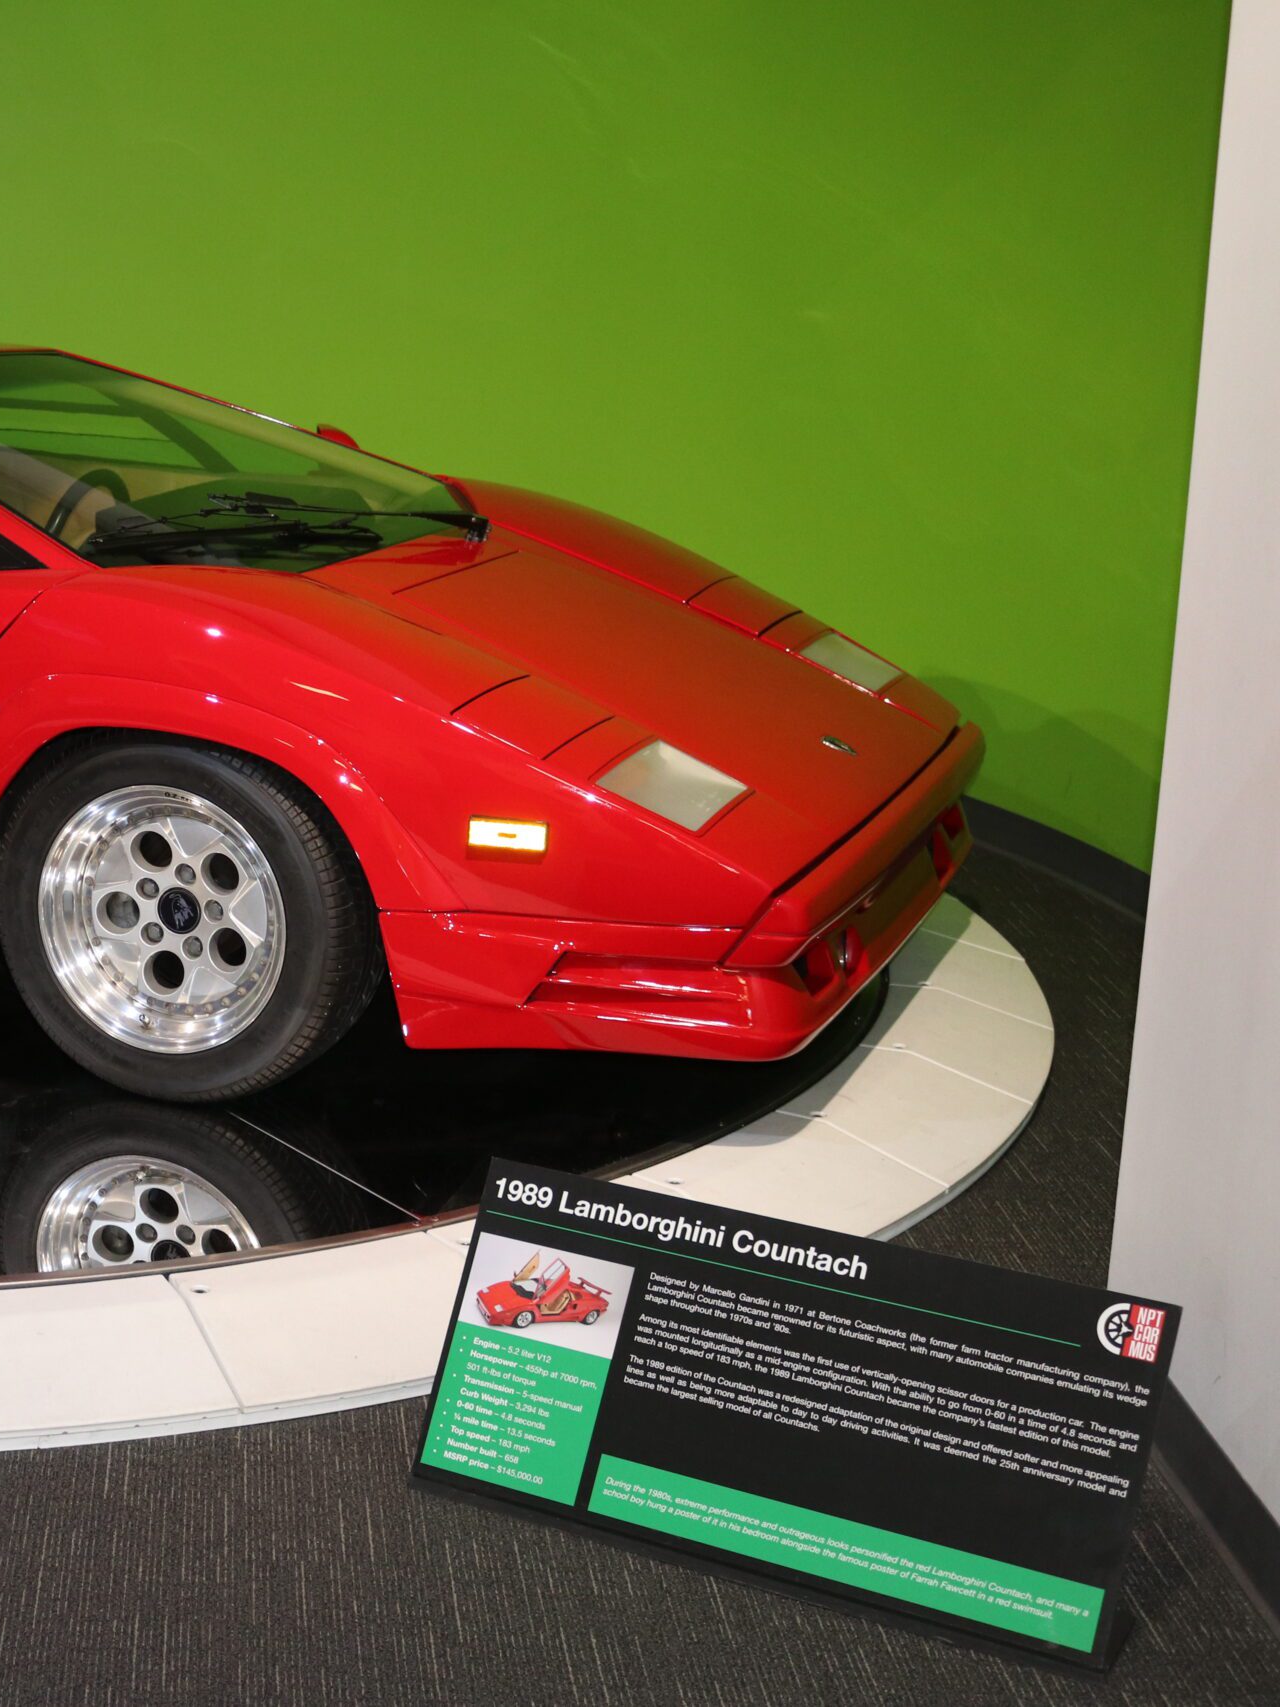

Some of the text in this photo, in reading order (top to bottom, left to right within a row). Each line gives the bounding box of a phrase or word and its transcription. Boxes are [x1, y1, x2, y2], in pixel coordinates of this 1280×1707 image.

[495, 1177, 868, 1280] 1989 Lamborghini Countach
[644, 1293, 669, 1305] shape
[669, 1298, 713, 1316] throughout
[729, 1312, 753, 1325] 1970s
[649, 1271, 687, 1287] Designed
[701, 1283, 736, 1299] Marcello
[738, 1292, 770, 1307] Gandini
[784, 1303, 804, 1314] 1971
[818, 1311, 852, 1326] Bertone
[854, 1319, 907, 1339] Coachworks
[929, 1336, 958, 1350] former
[961, 1344, 981, 1356] farm
[984, 1349, 1014, 1363] tractor
[1016, 1358, 1080, 1381] manufacturing
[1136, 1306, 1164, 1328] NPT
[472, 1336, 501, 1350] Engine
[520, 1349, 536, 1359] liter
[536, 1352, 552, 1364] V12
[647, 1282, 1148, 1407] Lamborghini Countach became renowned futuristic aspect, with many automobile companies emulating wedge
[1127, 1339, 1157, 1362] MUS
[1132, 1323, 1161, 1345] CAR
[466, 1361, 480, 1371] 501
[502, 1372, 512, 1380] of
[510, 1373, 537, 1387] torque
[469, 1349, 518, 1368] Horsepower
[524, 1364, 549, 1377] 455hp
[549, 1371, 559, 1379] at
[559, 1372, 579, 1384] 7000
[638, 1313, 1140, 1441] Among most identifiable elements first vertically-opening scissor doors production engine
[459, 1386, 480, 1399] Curb
[480, 1392, 509, 1407] Weight
[537, 1407, 550, 1417] lbs
[463, 1373, 515, 1395] Transmission
[554, 1400, 583, 1413] manual
[623, 1375, 820, 1432] became largest selling model Countachs.
[633, 1335, 656, 1346] reach
[678, 1346, 705, 1358] speed
[716, 1354, 731, 1364] 183
[770, 1367, 791, 1379] 1989
[791, 1372, 843, 1392] Lamborghini
[843, 1385, 885, 1402] Countach
[886, 1395, 921, 1411] became
[986, 1420, 1017, 1435] fastest
[1018, 1429, 1049, 1443] edition
[1061, 1438, 1079, 1450] this
[1080, 1444, 1111, 1458] model.
[654, 1329, 1117, 1447] mounted longitudinally mid-engine configuration. With ability from 0-60 time 4.8 seconds
[462, 1416, 480, 1426] mile
[480, 1419, 499, 1431] time
[523, 1432, 556, 1447] seconds
[474, 1404, 494, 1416] time
[512, 1416, 546, 1430] seconds
[625, 1364, 1106, 1493] lines well being more adaptable driving activities. deemed 25th anniversary model
[646, 1358, 1130, 1488] 1989 edition Countach redesigned adaptation original design offered softer more appealing
[446, 1437, 519, 1464] Number built 658
[450, 1424, 530, 1453] Top speed 183 mph
[443, 1449, 468, 1463] MSRP
[467, 1458, 490, 1470] price
[602, 1488, 630, 1501] school
[673, 1508, 702, 1520] poster
[741, 1525, 780, 1543] bedroom
[779, 1537, 821, 1554] alongside
[837, 1552, 869, 1568] famous
[869, 1562, 899, 1575] poster
[910, 1572, 939, 1587] Farrah
[939, 1580, 977, 1598] Fawcett
[604, 1476, 632, 1492] During
[674, 1497, 708, 1511] extreme
[707, 1506, 760, 1526] performance
[777, 1525, 825, 1544] outrageous
[825, 1537, 850, 1550] looks
[849, 1545, 900, 1564] personified
[931, 1566, 987, 1588] Lamborghini
